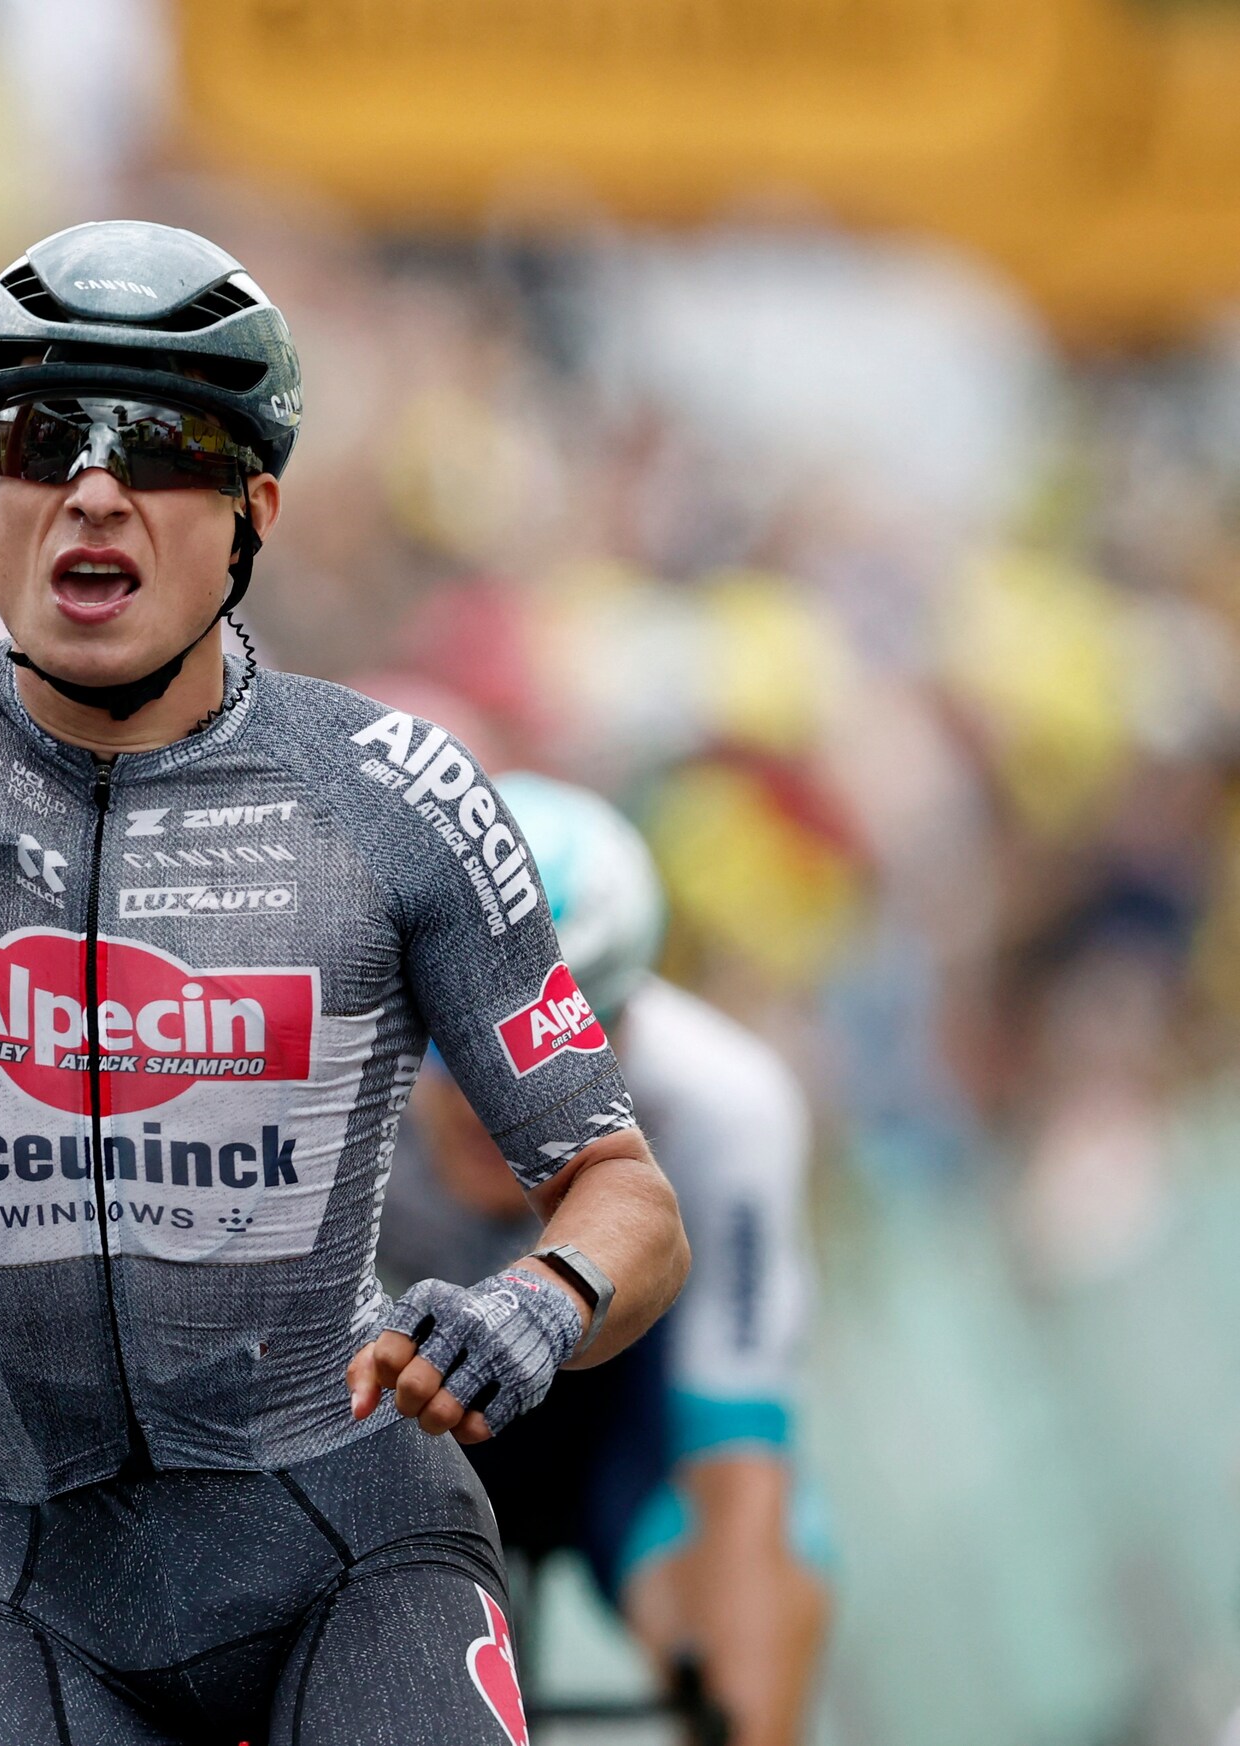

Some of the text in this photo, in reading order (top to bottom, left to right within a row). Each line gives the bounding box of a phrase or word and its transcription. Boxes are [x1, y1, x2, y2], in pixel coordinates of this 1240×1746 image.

[73, 279, 158, 299] CANYON
[270, 385, 300, 419] CAN
[6, 781, 49, 818] TEAM
[9, 769, 67, 814] WORLD
[182, 799, 298, 829] ZWIFT
[348, 711, 538, 926] Alpecin
[122, 844, 297, 869] CANYON
[359, 758, 507, 937] GREY ATTACK SHAMPOO
[529, 988, 592, 1049] Alpe
[551, 1029, 572, 1049] GREY
[144, 1056, 265, 1076] SHAMPOO
[0, 1200, 195, 1230] WINDOWS
